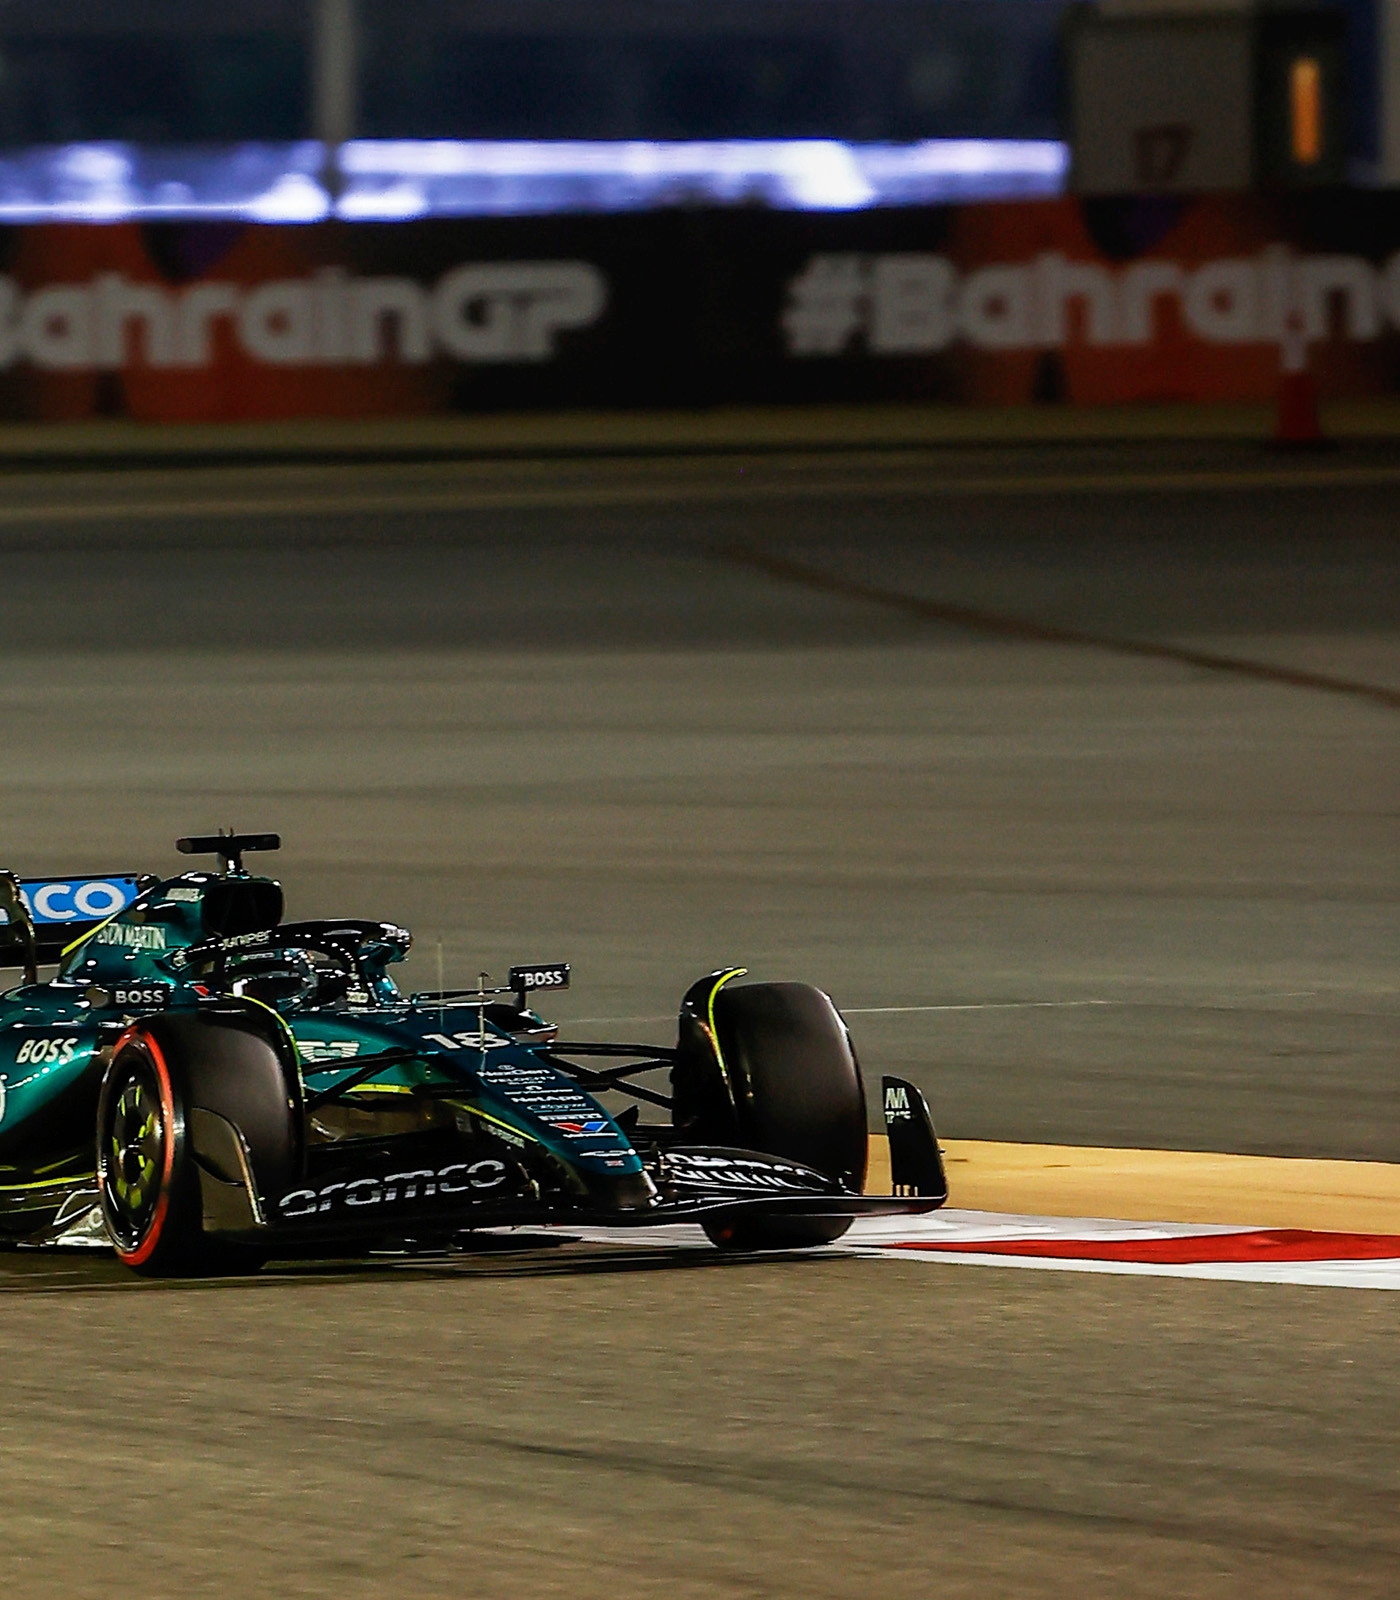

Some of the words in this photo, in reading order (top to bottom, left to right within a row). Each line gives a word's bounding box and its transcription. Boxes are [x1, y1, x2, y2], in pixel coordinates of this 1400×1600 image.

[784, 244, 1400, 354] #Bahrain
[524, 971, 563, 986] BOSS
[115, 990, 164, 1004] BOSS
[16, 1038, 79, 1064] BOSS
[421, 1032, 511, 1049] 18
[279, 1160, 506, 1217] aramco
